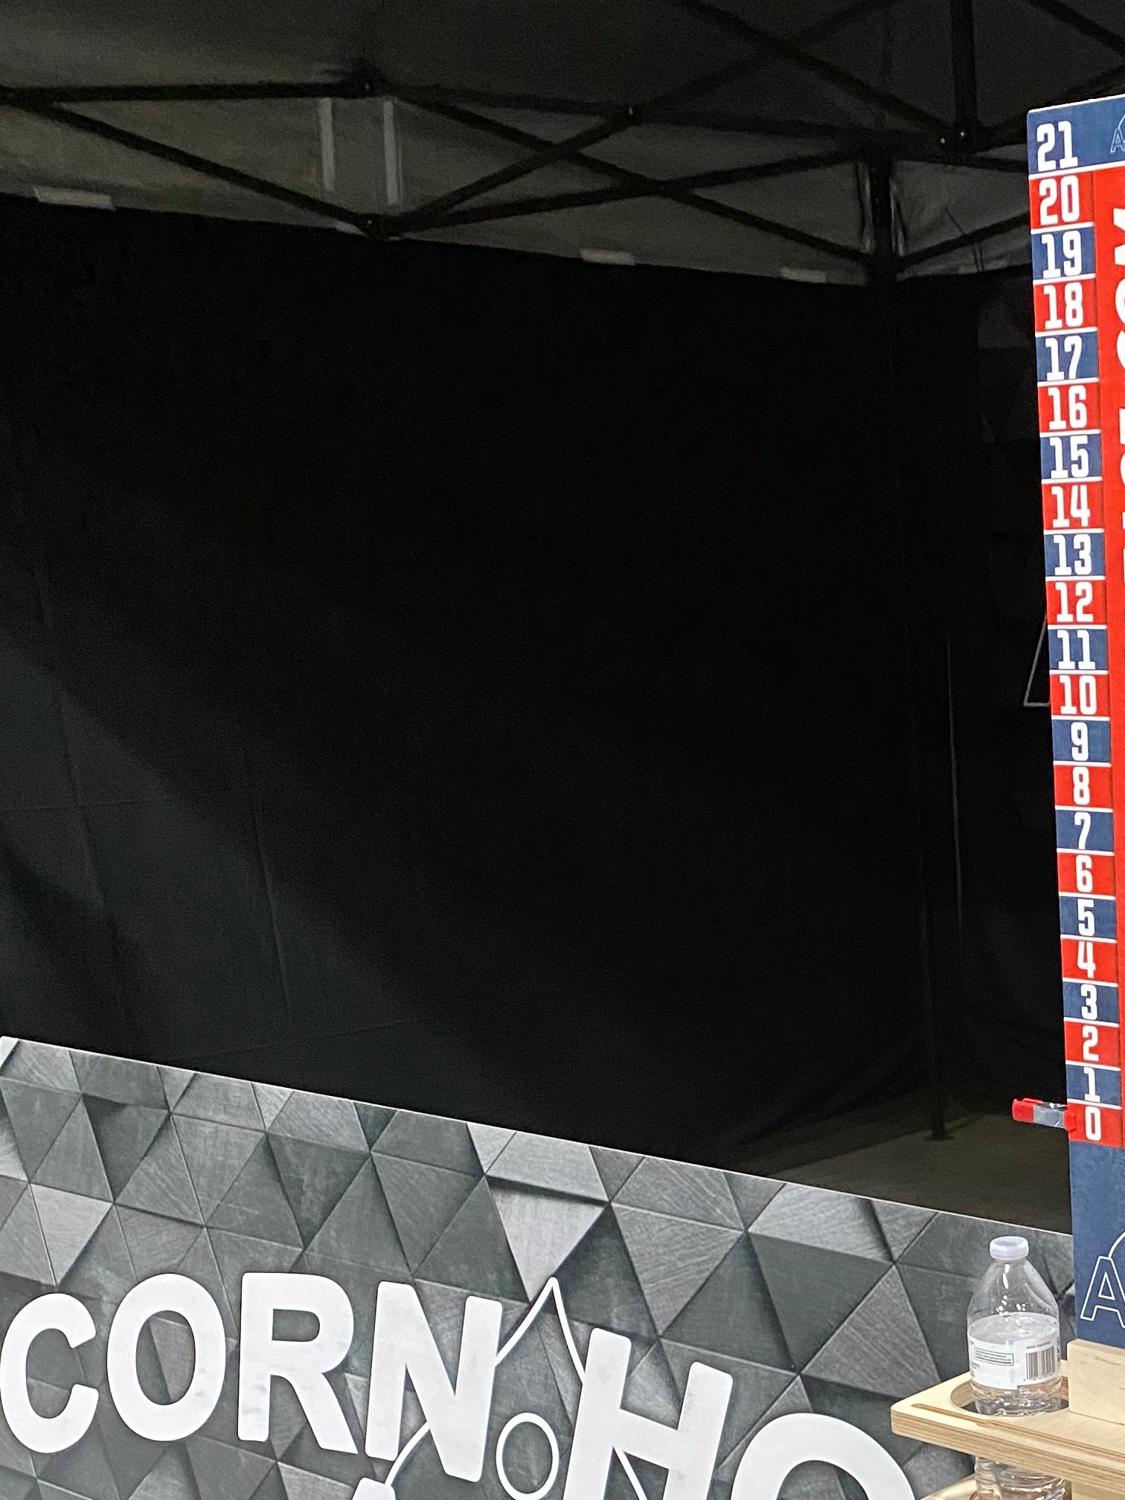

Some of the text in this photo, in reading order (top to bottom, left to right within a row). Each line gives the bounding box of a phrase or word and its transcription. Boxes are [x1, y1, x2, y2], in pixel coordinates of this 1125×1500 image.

[1036, 120, 1079, 172] 21
[1039, 175, 1080, 226] 20
[1041, 230, 1083, 279] 19
[1043, 281, 1084, 330] 18
[1045, 335, 1083, 381] 17
[1047, 384, 1088, 430] 16
[1050, 435, 1090, 478] 15
[1051, 484, 1091, 528] 14
[1053, 533, 1093, 576] 13
[1055, 581, 1094, 623] 12
[1056, 629, 1096, 670] 11
[1059, 674, 1097, 716] 10
[1070, 721, 1089, 762] 9
[1072, 766, 1090, 806] 8
[1074, 812, 1091, 849] 7
[1075, 854, 1093, 893] 6
[1077, 898, 1095, 937] 5
[1077, 940, 1096, 979] 4
[1080, 984, 1098, 1021] 3
[1082, 1025, 1099, 1062] 2
[1083, 1067, 1101, 1102] 1
[1085, 1105, 1102, 1141] 0
